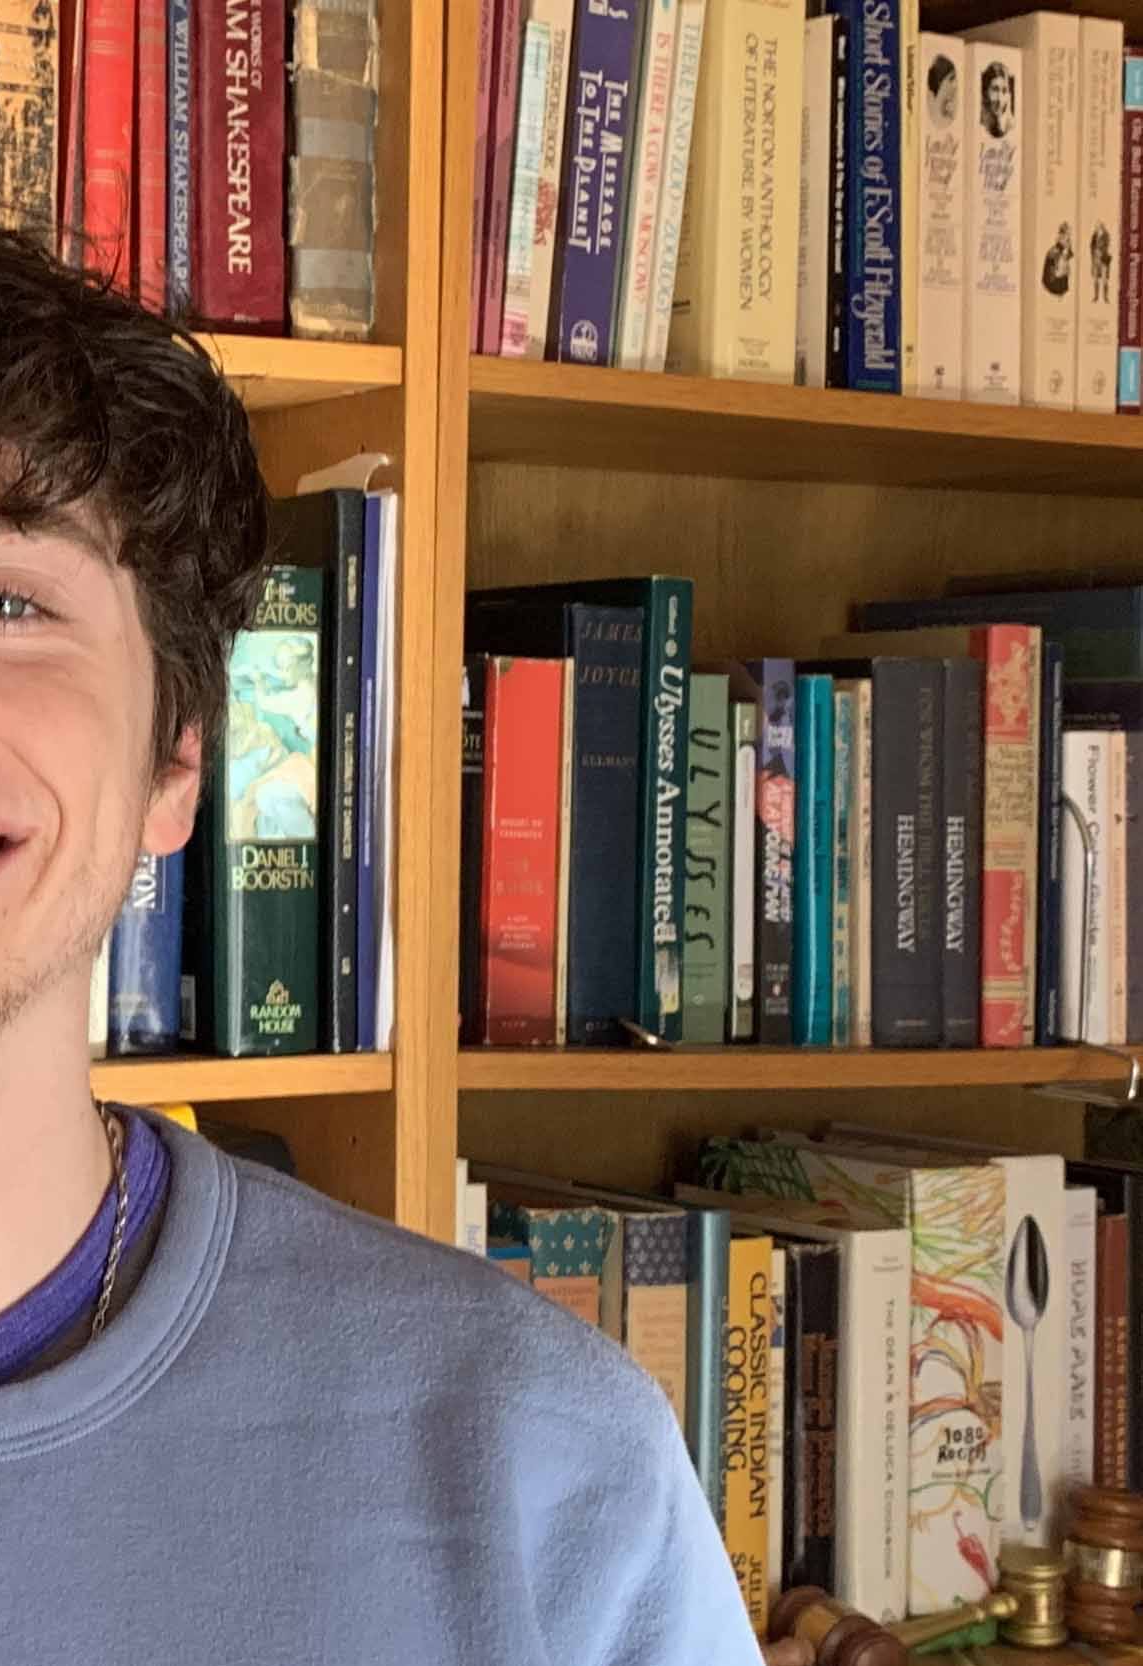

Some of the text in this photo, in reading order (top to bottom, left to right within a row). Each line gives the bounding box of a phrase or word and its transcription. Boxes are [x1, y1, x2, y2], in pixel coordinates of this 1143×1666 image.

[173, 19, 189, 124] WILLIAM
[226, 48, 252, 274] SHAKESPEARE
[738, 34, 759, 313] OF LITERATURE BY WOMEN
[757, 39, 778, 305] THE NORTON ANTHOLOGY
[851, 1, 895, 372] Short Stories of Fitzgerald
[653, 665, 685, 945] Ulysses Annotated
[685, 727, 723, 950] ULYSSES
[1087, 744, 1101, 815] Flower
[231, 866, 315, 891] BOORSTIN
[241, 845, 299, 869] DANIEL
[897, 814, 915, 954] HEMINGWAY
[945, 815, 965, 953] HEMINGWAY
[249, 1004, 303, 1020] RANDOM
[258, 1019, 295, 1034] HOUSE
[724, 1325, 748, 1472] COOKING
[747, 1271, 768, 1519] CLASSIC INDIAN
